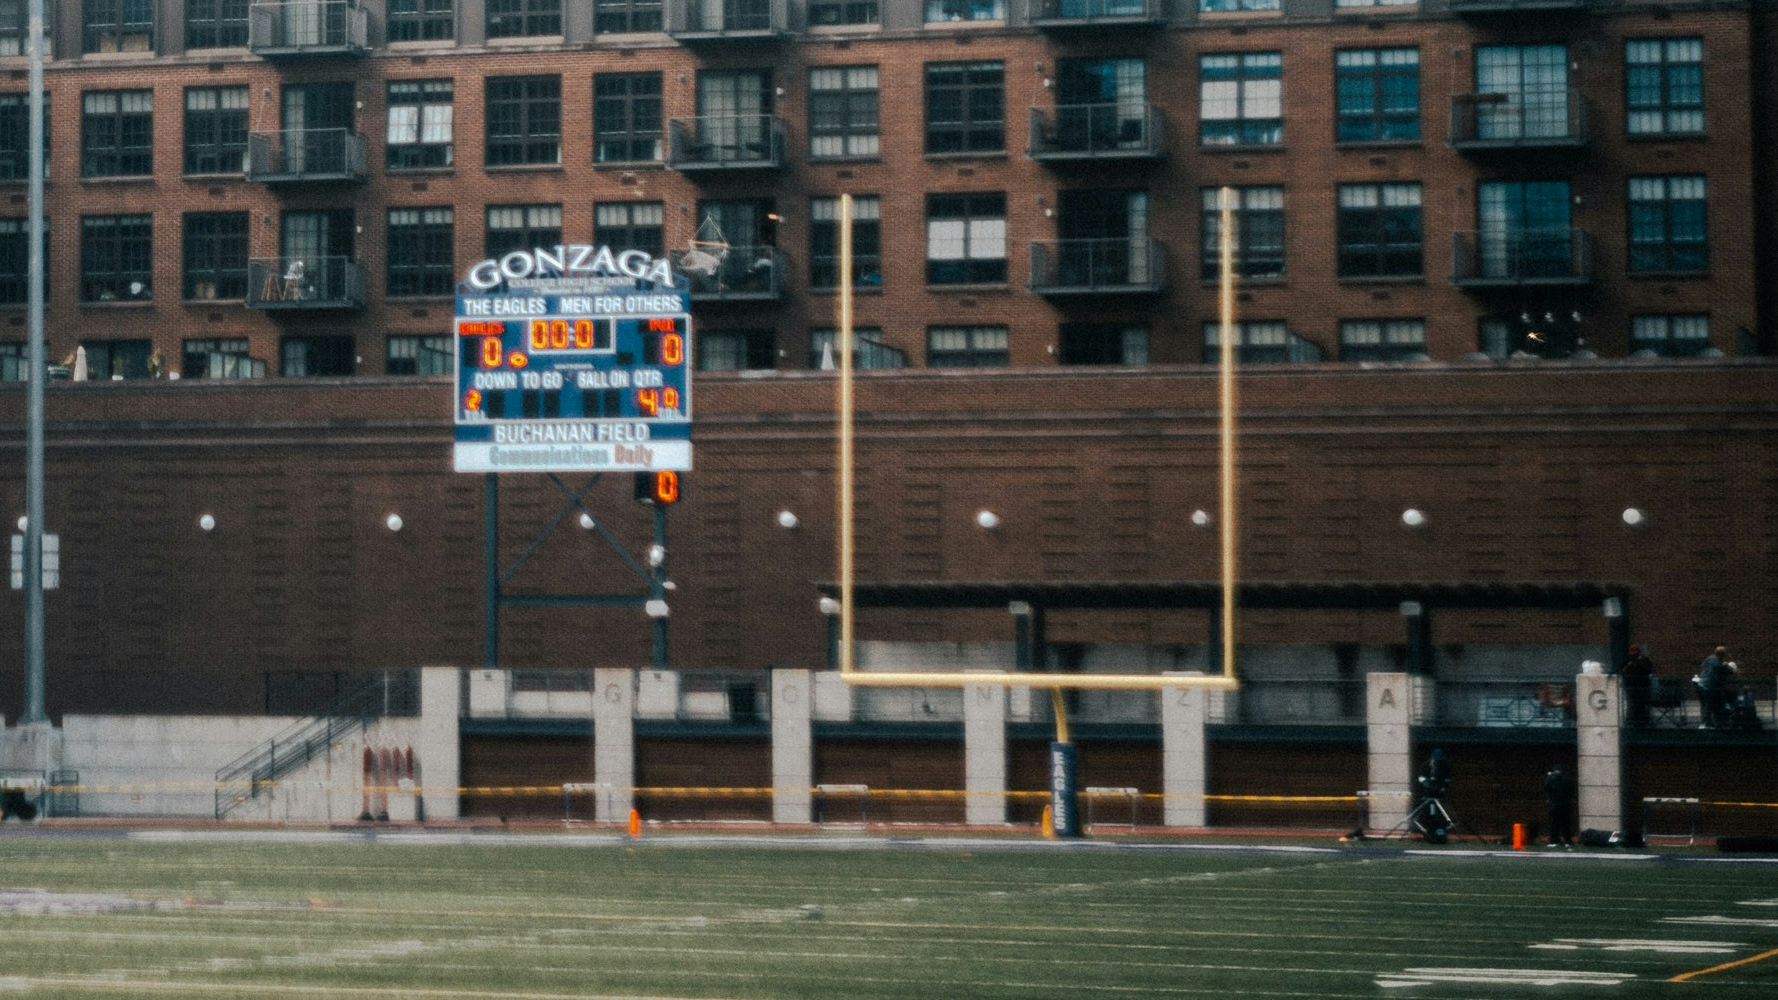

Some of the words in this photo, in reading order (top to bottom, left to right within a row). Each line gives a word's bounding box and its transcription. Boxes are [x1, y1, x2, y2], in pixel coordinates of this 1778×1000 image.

[469, 243, 675, 289] GONZAGA
[464, 298, 492, 315] THE
[494, 297, 547, 314] EAGLES
[560, 296, 591, 314] MEN
[595, 296, 624, 313] FOR
[626, 294, 683, 312] OTHERS
[482, 336, 503, 369] 0
[662, 333, 684, 366] 0
[474, 372, 518, 390] DOWN
[521, 372, 540, 389] TO
[542, 371, 563, 389] GO
[577, 371, 610, 389] BALL
[610, 370, 630, 388] ON
[633, 369, 663, 387] QTR
[638, 388, 659, 416] 4
[494, 424, 594, 443] BUCHANAN
[597, 423, 650, 442] FIELD
[614, 444, 653, 467] Daily
[656, 470, 678, 503] 0
[1378, 688, 1397, 709] A
[1587, 690, 1608, 711] G
[1053, 751, 1067, 830] EAGLES
